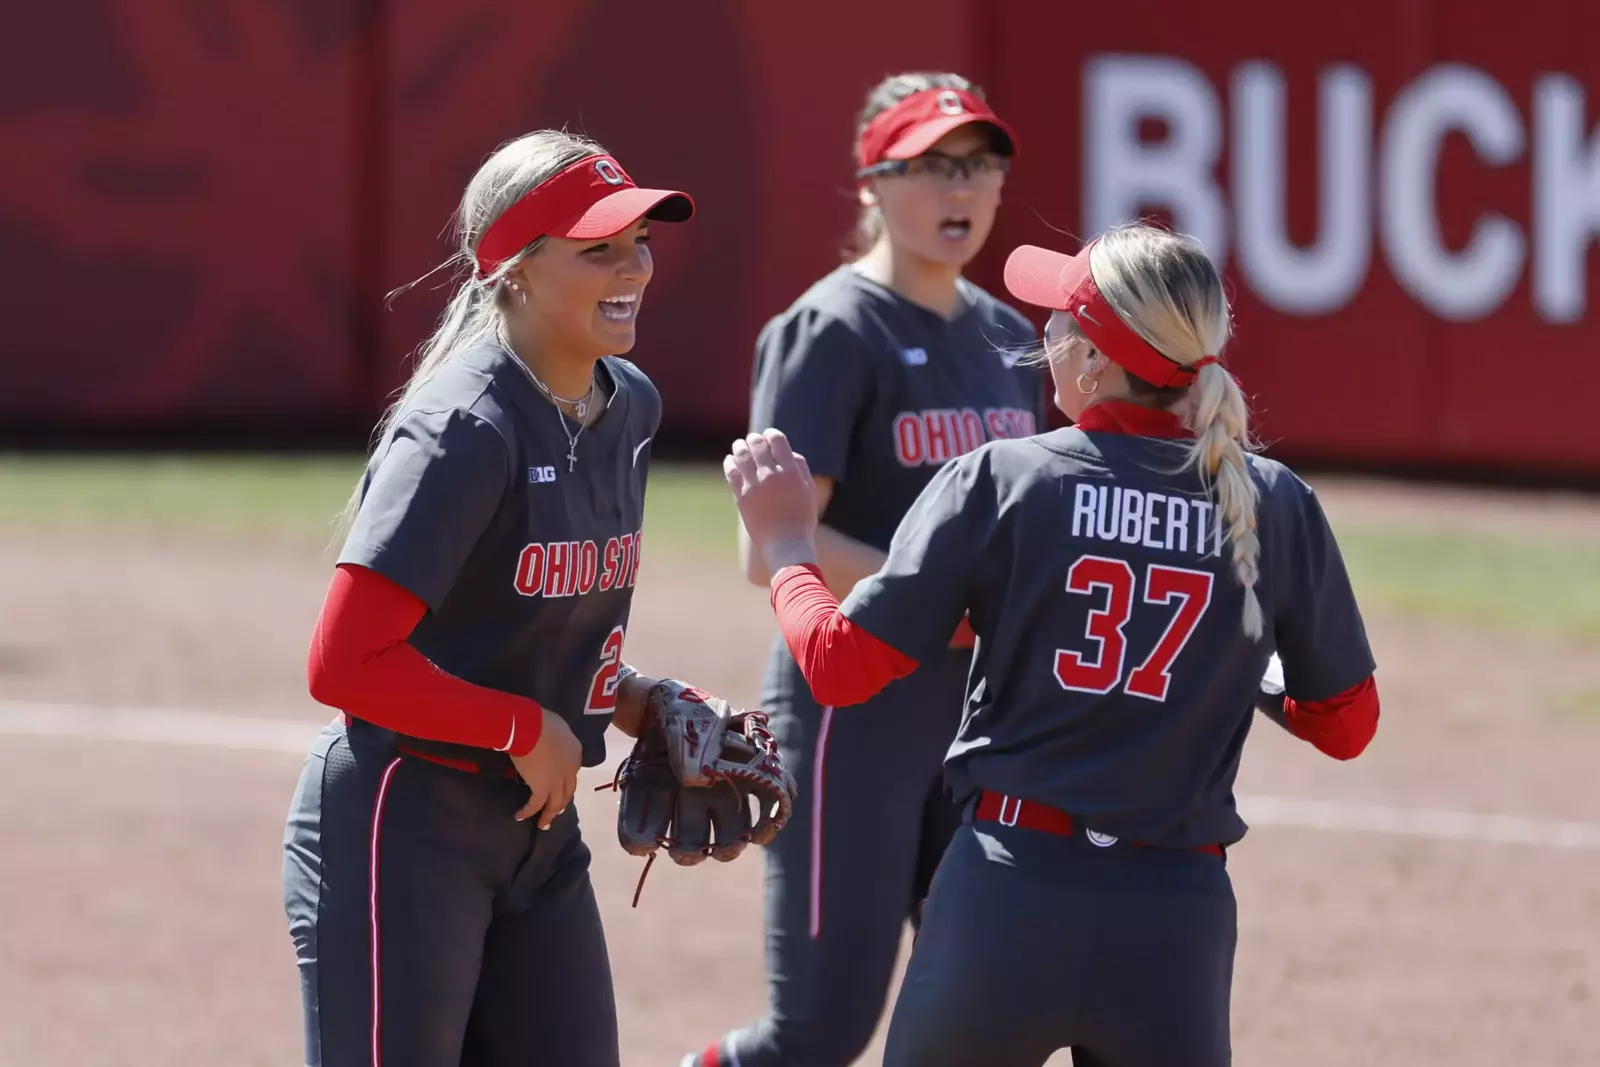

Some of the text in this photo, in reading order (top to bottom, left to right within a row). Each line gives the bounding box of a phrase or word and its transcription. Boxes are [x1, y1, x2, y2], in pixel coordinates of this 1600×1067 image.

[594, 159, 624, 186] O
[893, 408, 986, 467] OHIO
[513, 540, 598, 598] OHIO
[1053, 554, 1215, 702] 37
[583, 624, 625, 715] 2
